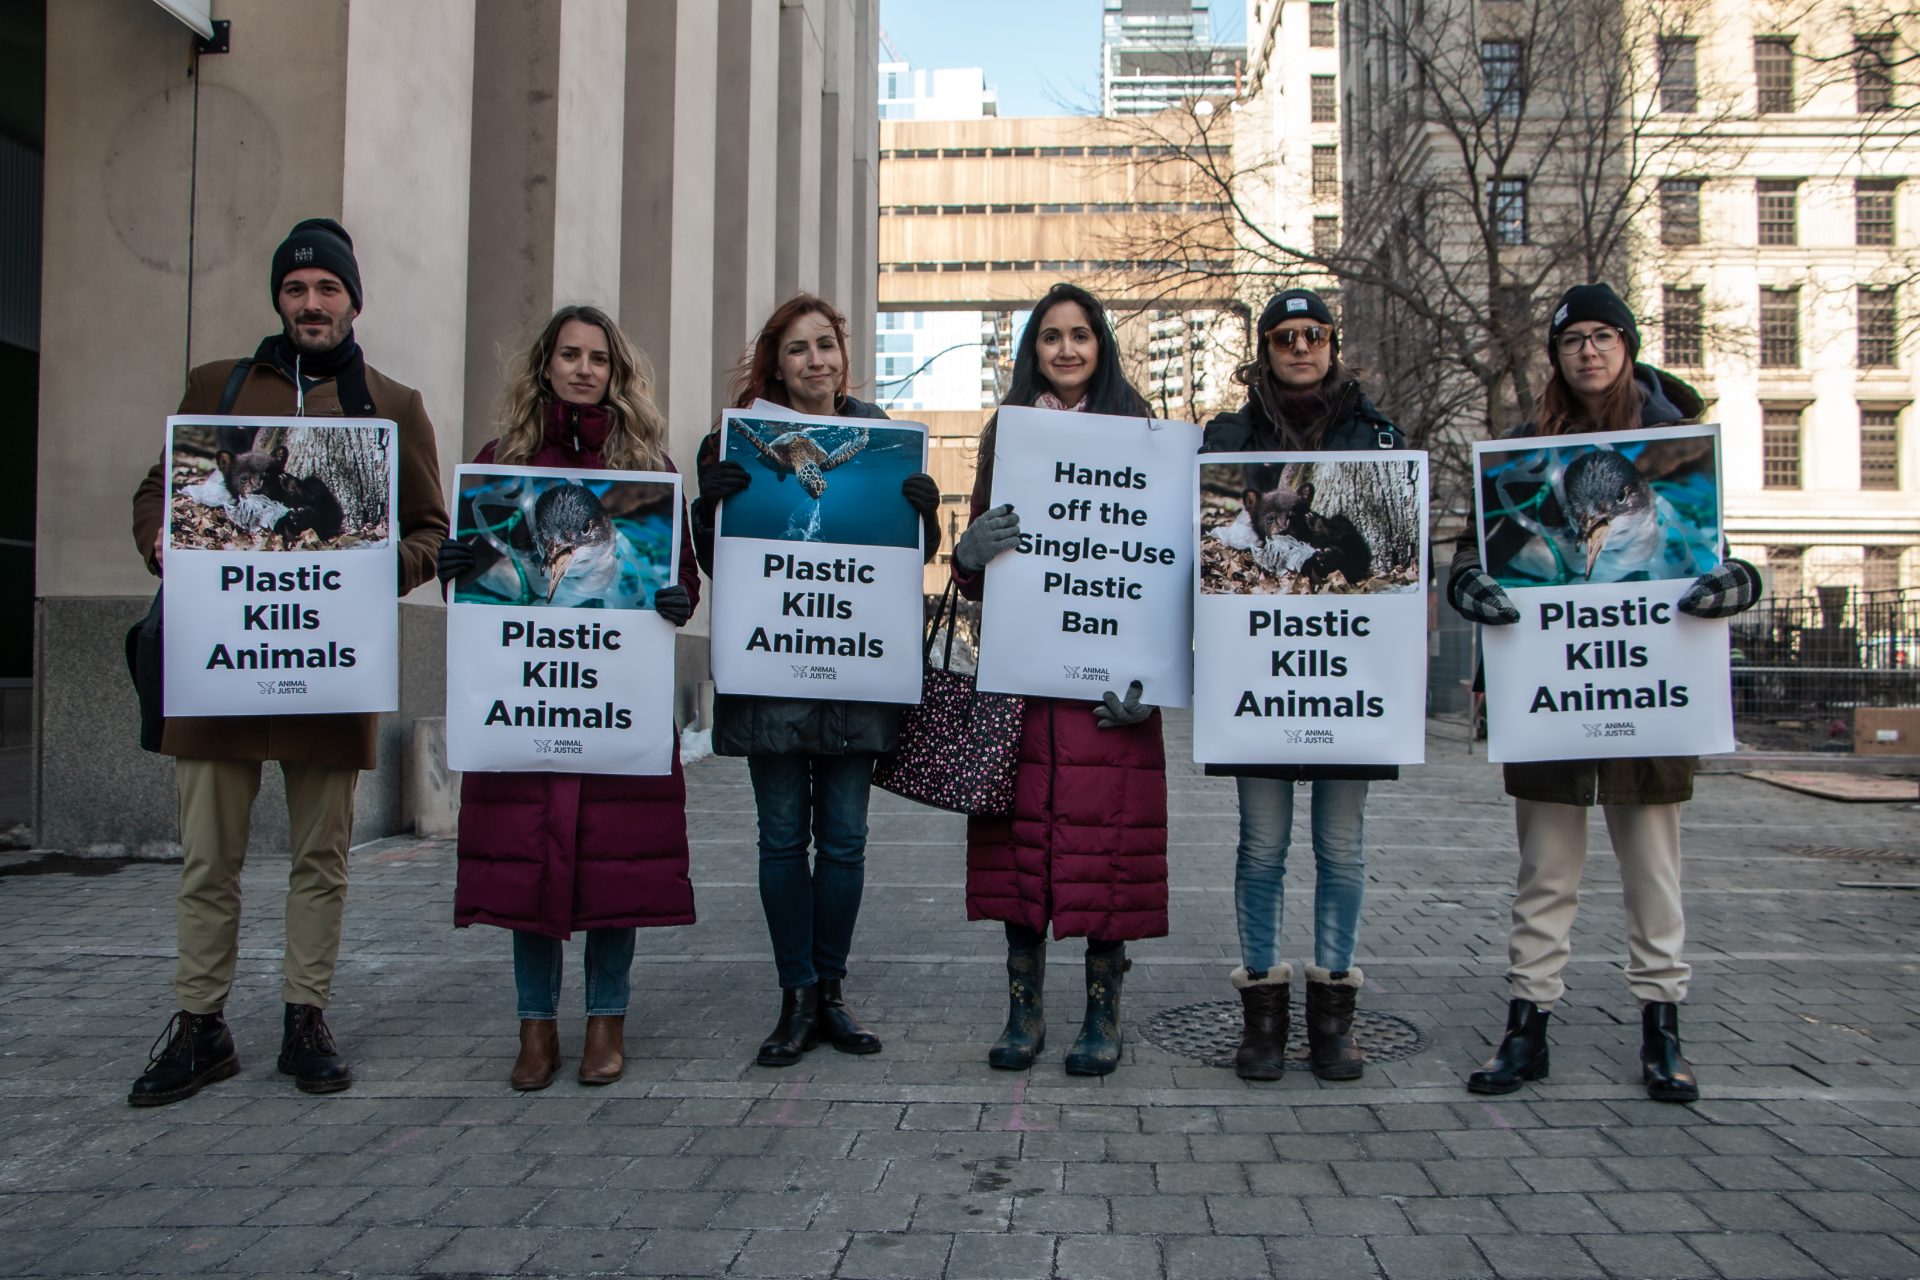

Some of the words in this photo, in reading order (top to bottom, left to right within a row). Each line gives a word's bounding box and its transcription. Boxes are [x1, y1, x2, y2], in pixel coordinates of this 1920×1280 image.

[1054, 461, 1147, 490] Hands
[1048, 498, 1092, 522] off
[1099, 502, 1148, 527] the
[1015, 532, 1175, 565] Single-Use
[221, 564, 342, 593] Plastic
[763, 553, 875, 584] Plastic
[1043, 571, 1143, 601] Plastic
[244, 603, 320, 631] Kills
[782, 591, 853, 620] Kills
[1539, 596, 1671, 631] Plastic
[501, 620, 622, 651] Plastic
[1061, 610, 1119, 636] Ban
[1249, 609, 1371, 637] Plastic
[205, 641, 357, 670] Animals
[745, 626, 884, 659] Animals
[1565, 639, 1649, 671] Kills
[522, 660, 598, 690] Kills
[1081, 673, 1109, 682] JUSTICE
[1083, 667, 1109, 675] ANIMAL
[1271, 649, 1348, 678] Kills
[277, 687, 307, 695] JUSTICE
[1233, 689, 1384, 718] Animals
[1529, 679, 1689, 714] Animals
[484, 699, 632, 730] Animals
[1603, 729, 1635, 737] JUSTICE
